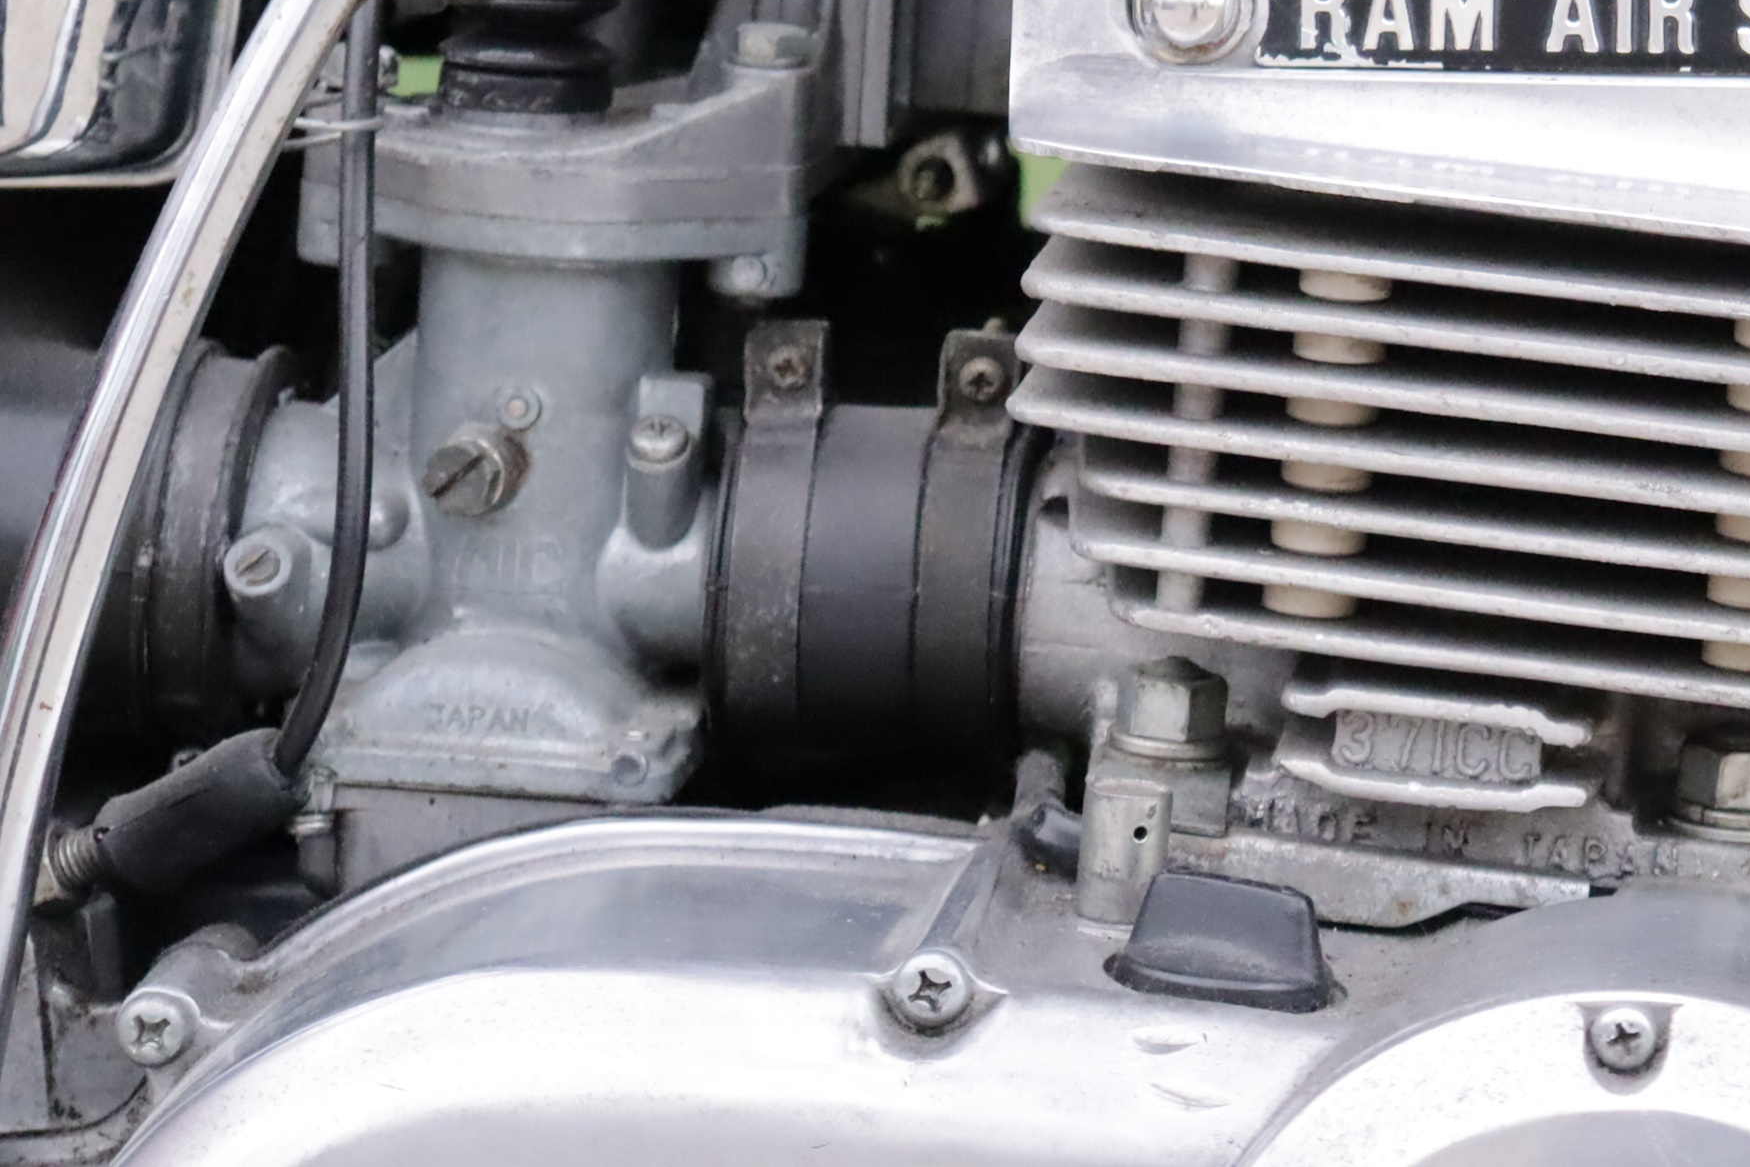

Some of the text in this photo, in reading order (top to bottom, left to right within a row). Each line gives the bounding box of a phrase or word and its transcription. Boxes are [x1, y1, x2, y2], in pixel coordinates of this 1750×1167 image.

[427, 702, 530, 733] JAPAN
[1242, 796, 1679, 880] MADE IN JAPAN
